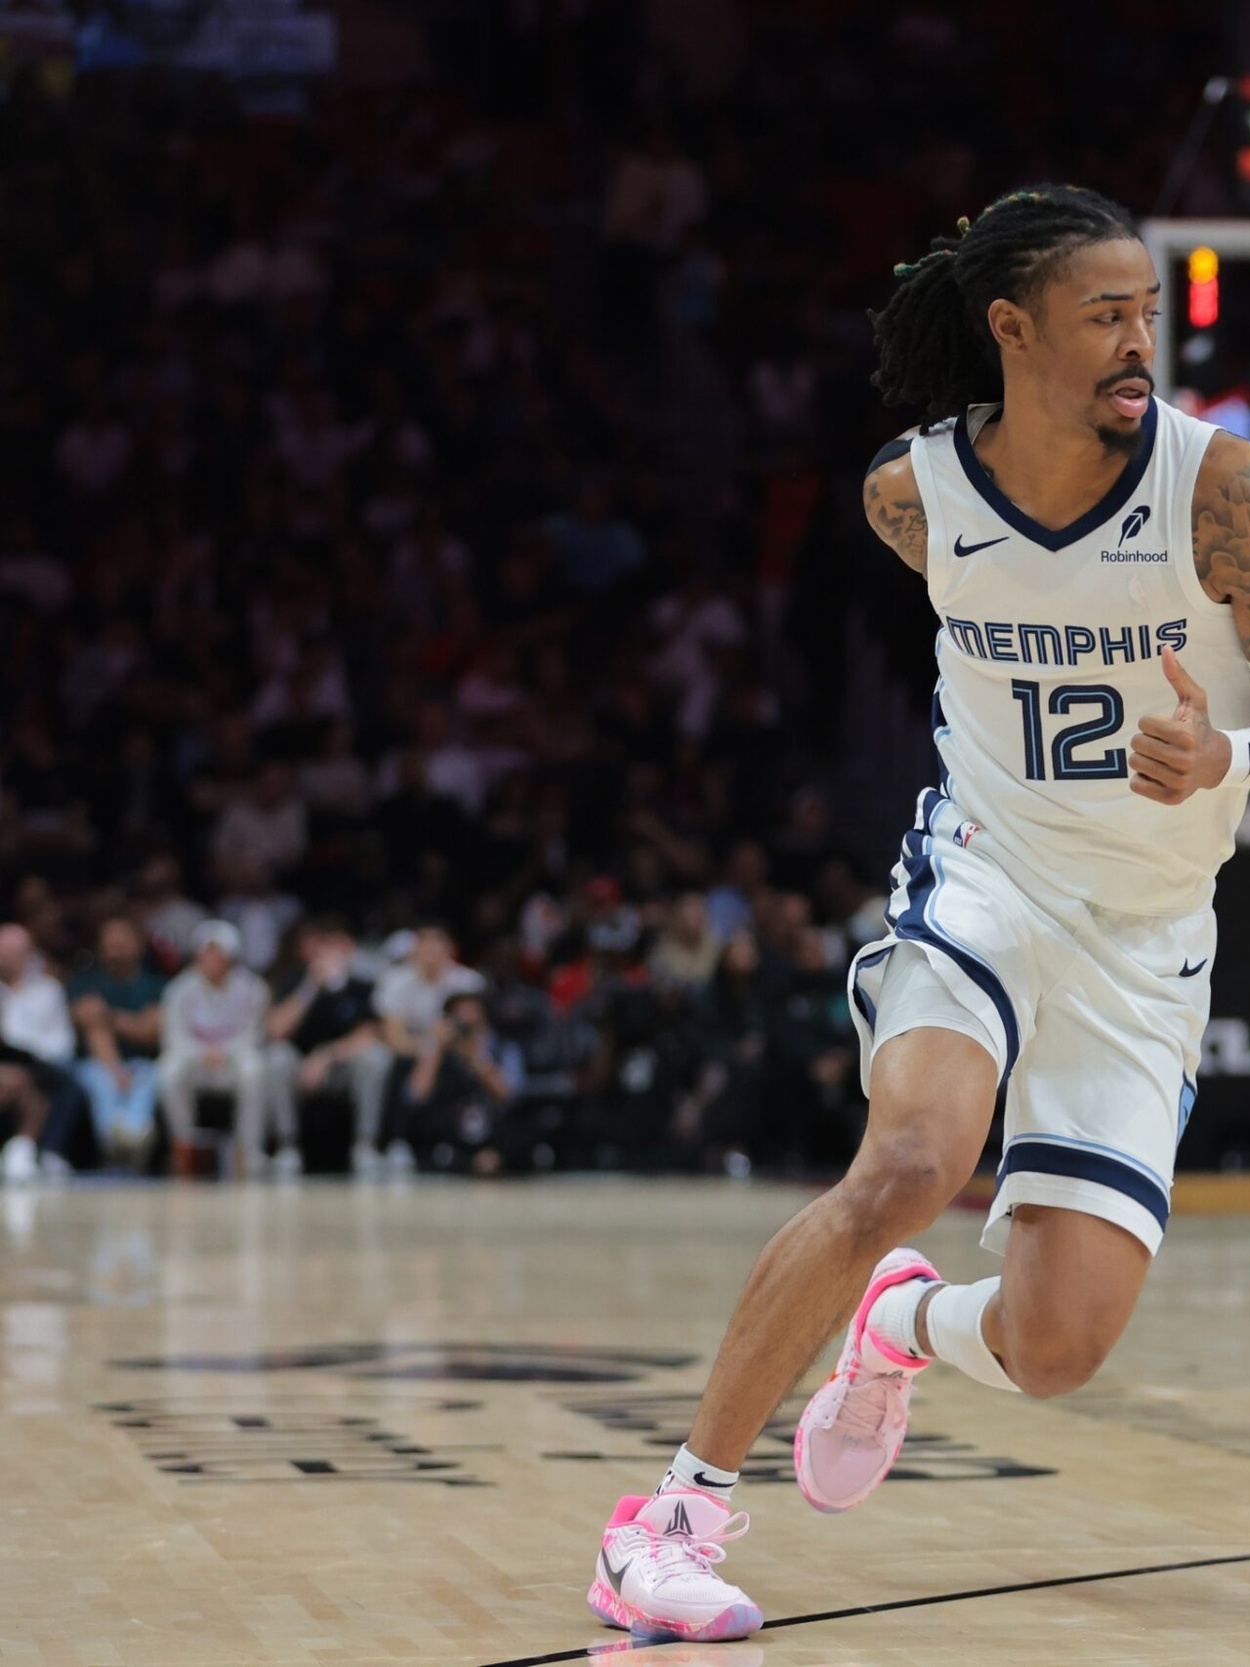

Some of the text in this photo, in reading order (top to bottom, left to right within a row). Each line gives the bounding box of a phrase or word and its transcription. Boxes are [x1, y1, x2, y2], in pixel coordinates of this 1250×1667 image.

[1100, 550, 1168, 562] Robinhood
[946, 616, 1187, 665] MEMPHIS
[1012, 678, 1128, 780] 12
